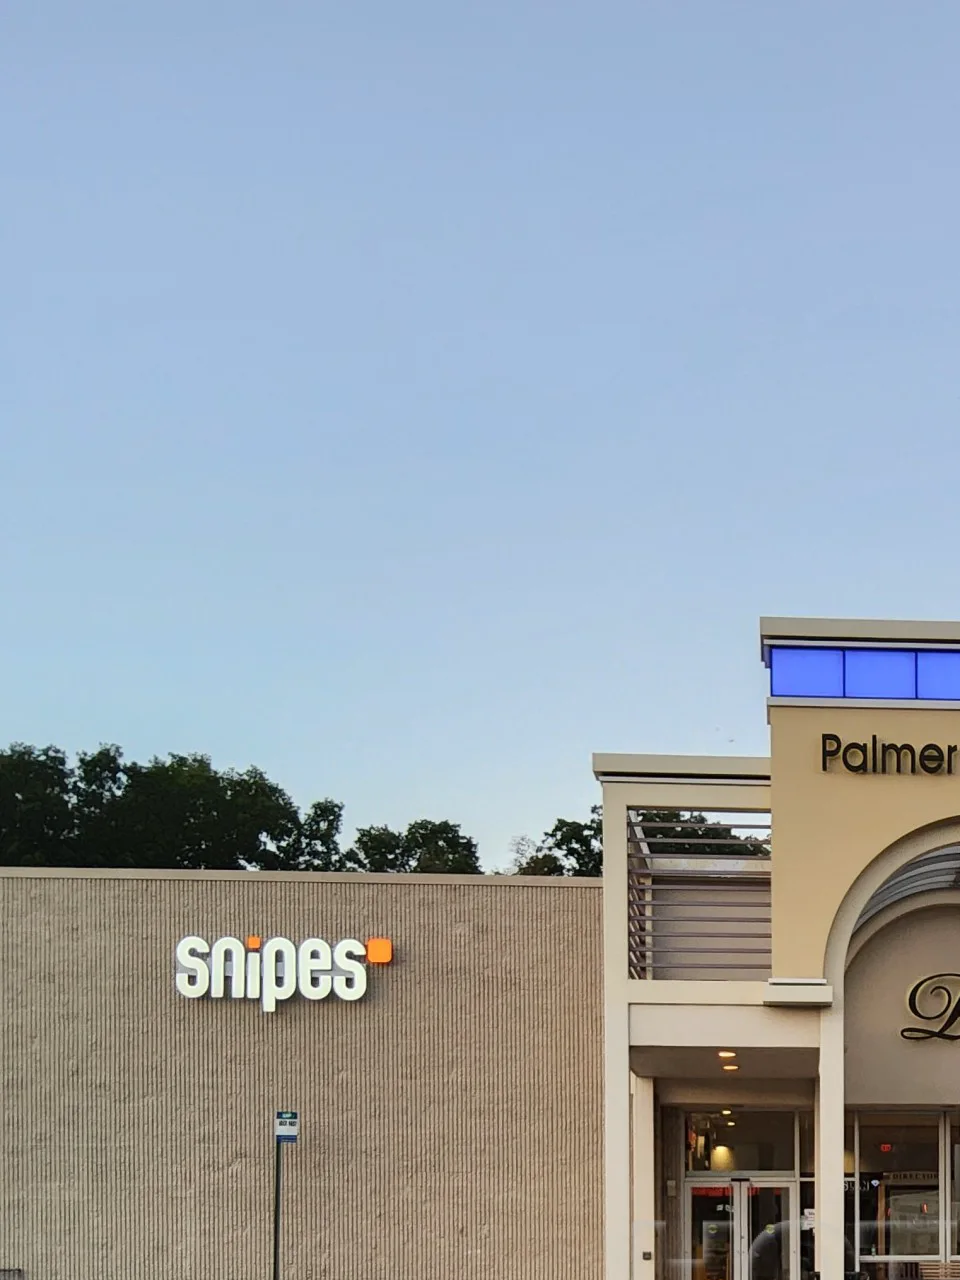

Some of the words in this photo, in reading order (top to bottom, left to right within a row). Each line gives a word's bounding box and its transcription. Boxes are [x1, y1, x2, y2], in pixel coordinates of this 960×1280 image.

[821, 733, 957, 774] Palmer
[175, 935, 367, 1012] snipes
[892, 1172, 939, 1180] DIRECTOR
